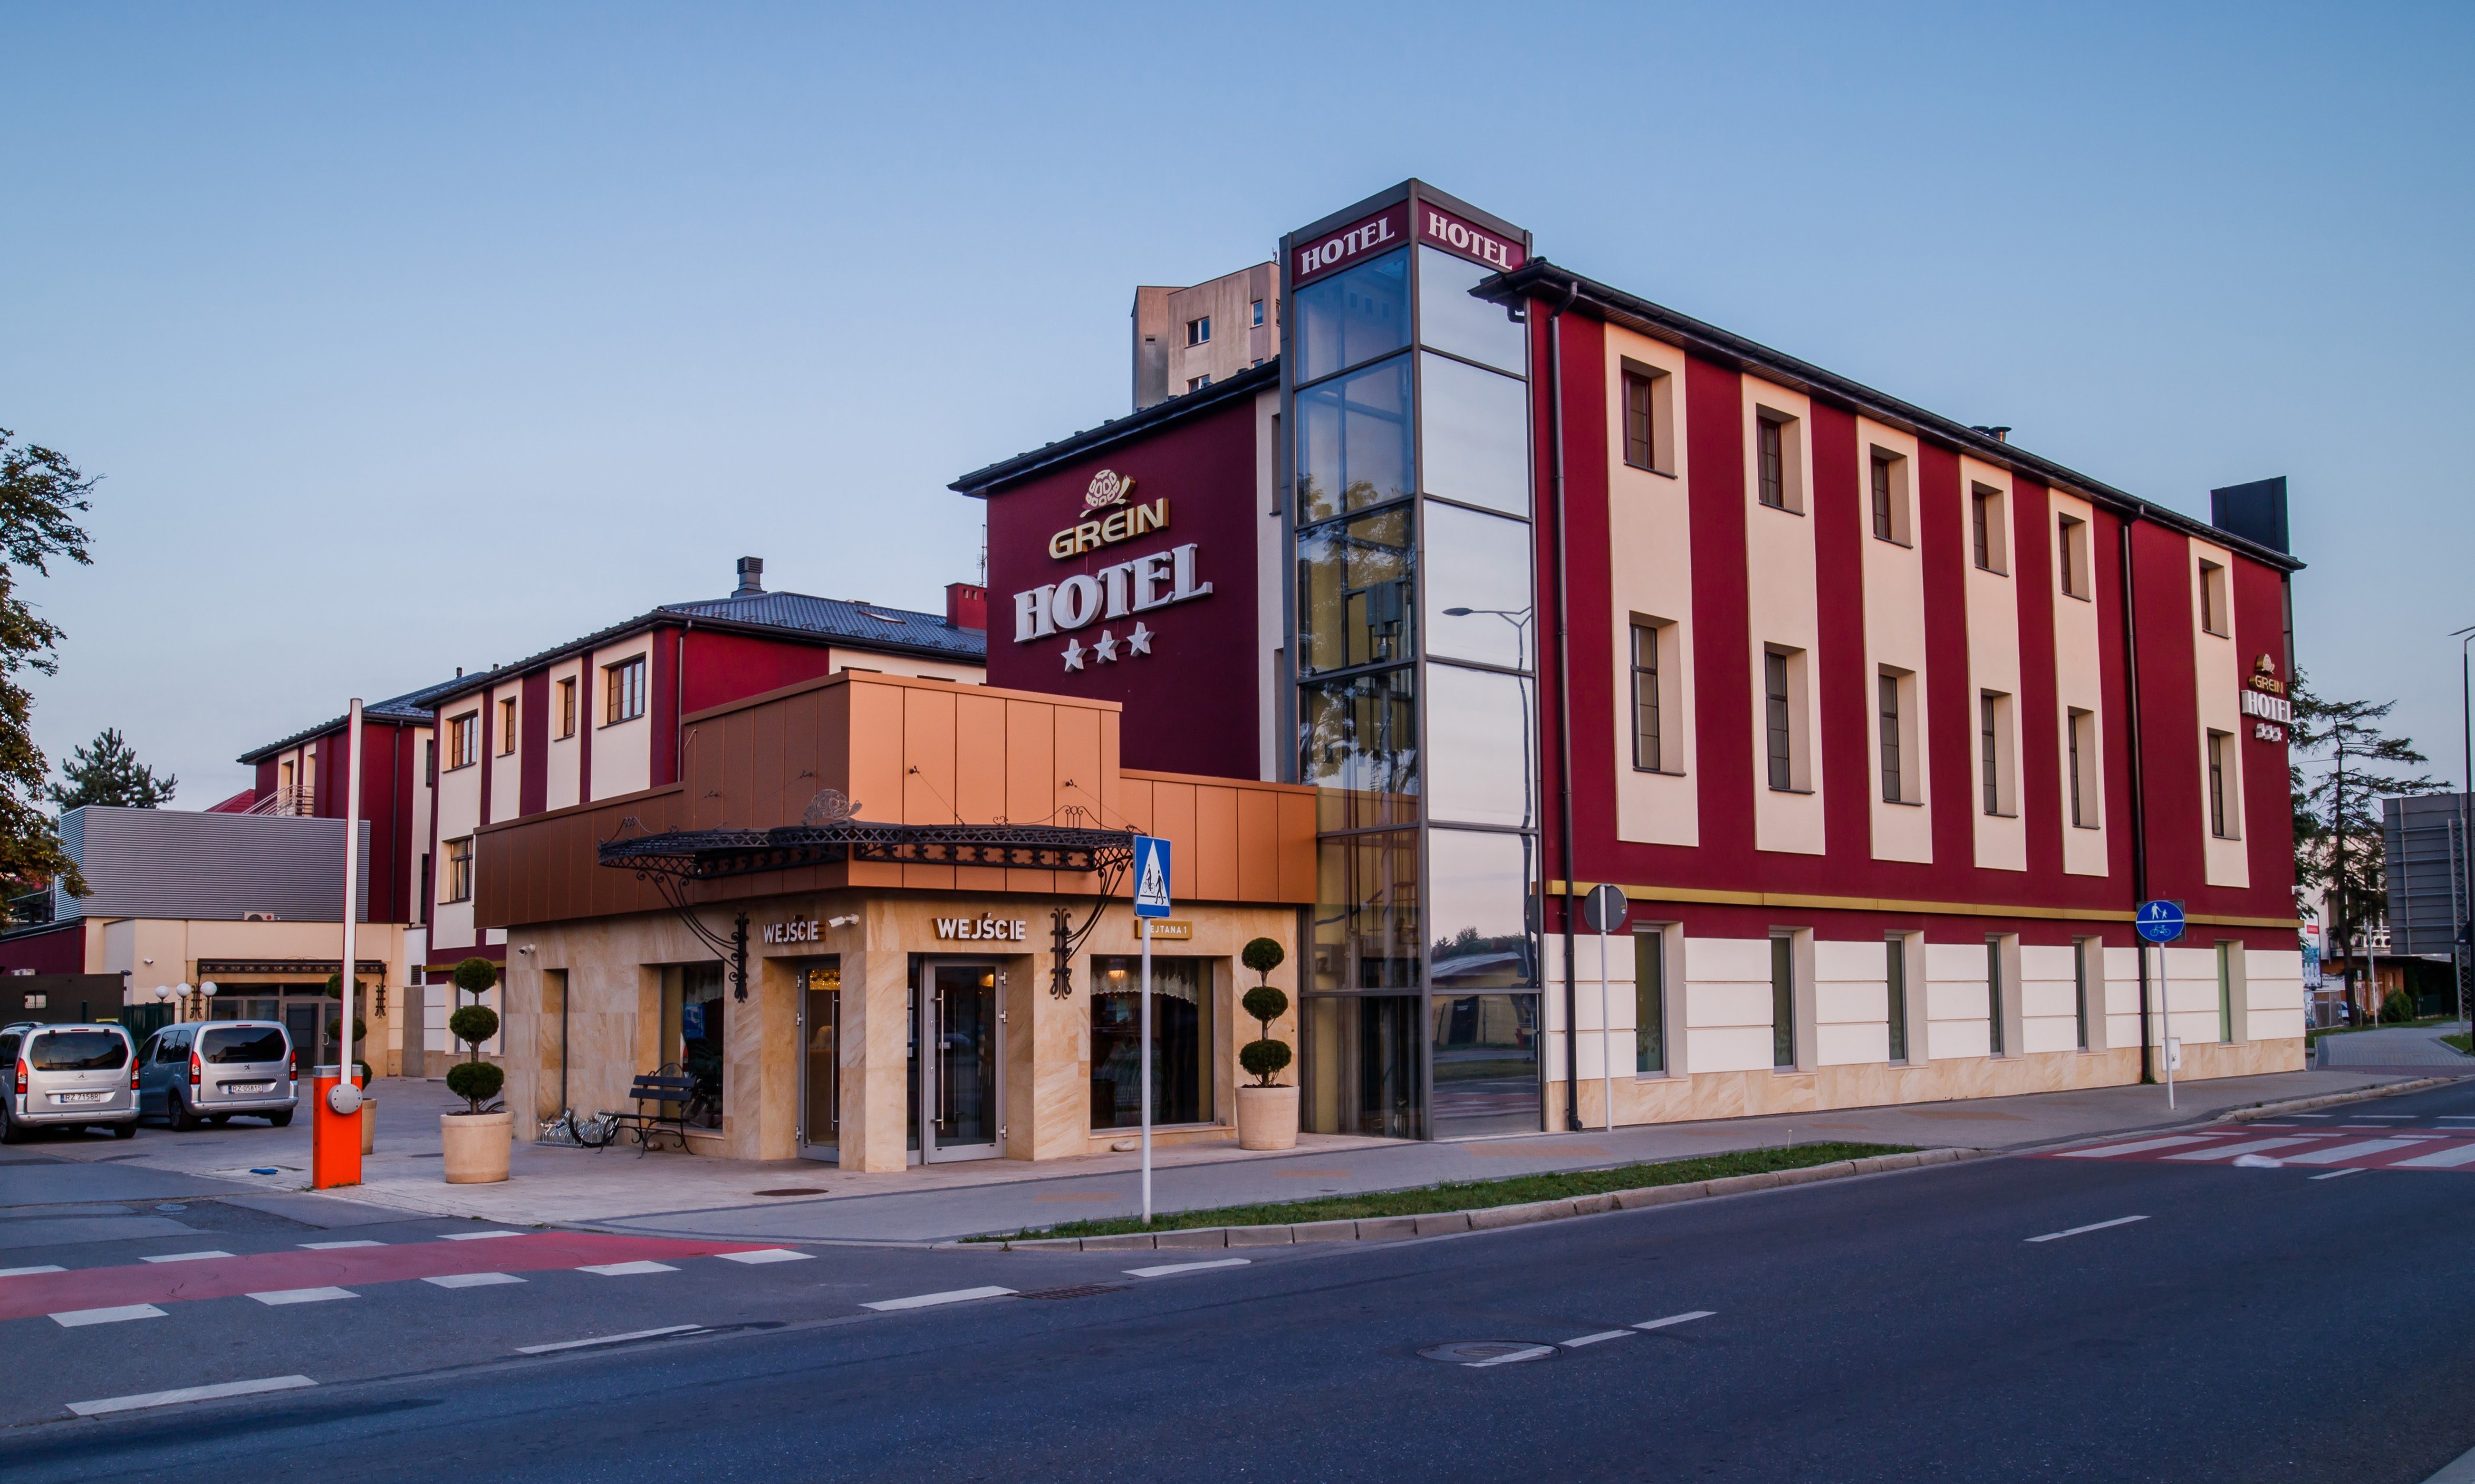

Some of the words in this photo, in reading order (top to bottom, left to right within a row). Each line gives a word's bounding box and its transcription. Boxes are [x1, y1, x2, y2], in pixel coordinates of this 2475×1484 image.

[1301, 217, 1395, 275] HOTEL
[1428, 211, 1512, 270] HOTEL
[1049, 498, 1168, 559] GREIN
[1013, 543, 1213, 642] HOTEL
[2254, 675, 2283, 694] GREIN
[2243, 690, 2293, 724] HOTEL
[763, 915, 819, 943] WEJŚCIE
[936, 912, 1026, 940] WEJŚCIE
[1147, 925, 1182, 934] EJTANA
[1184, 926, 1187, 934] 1
